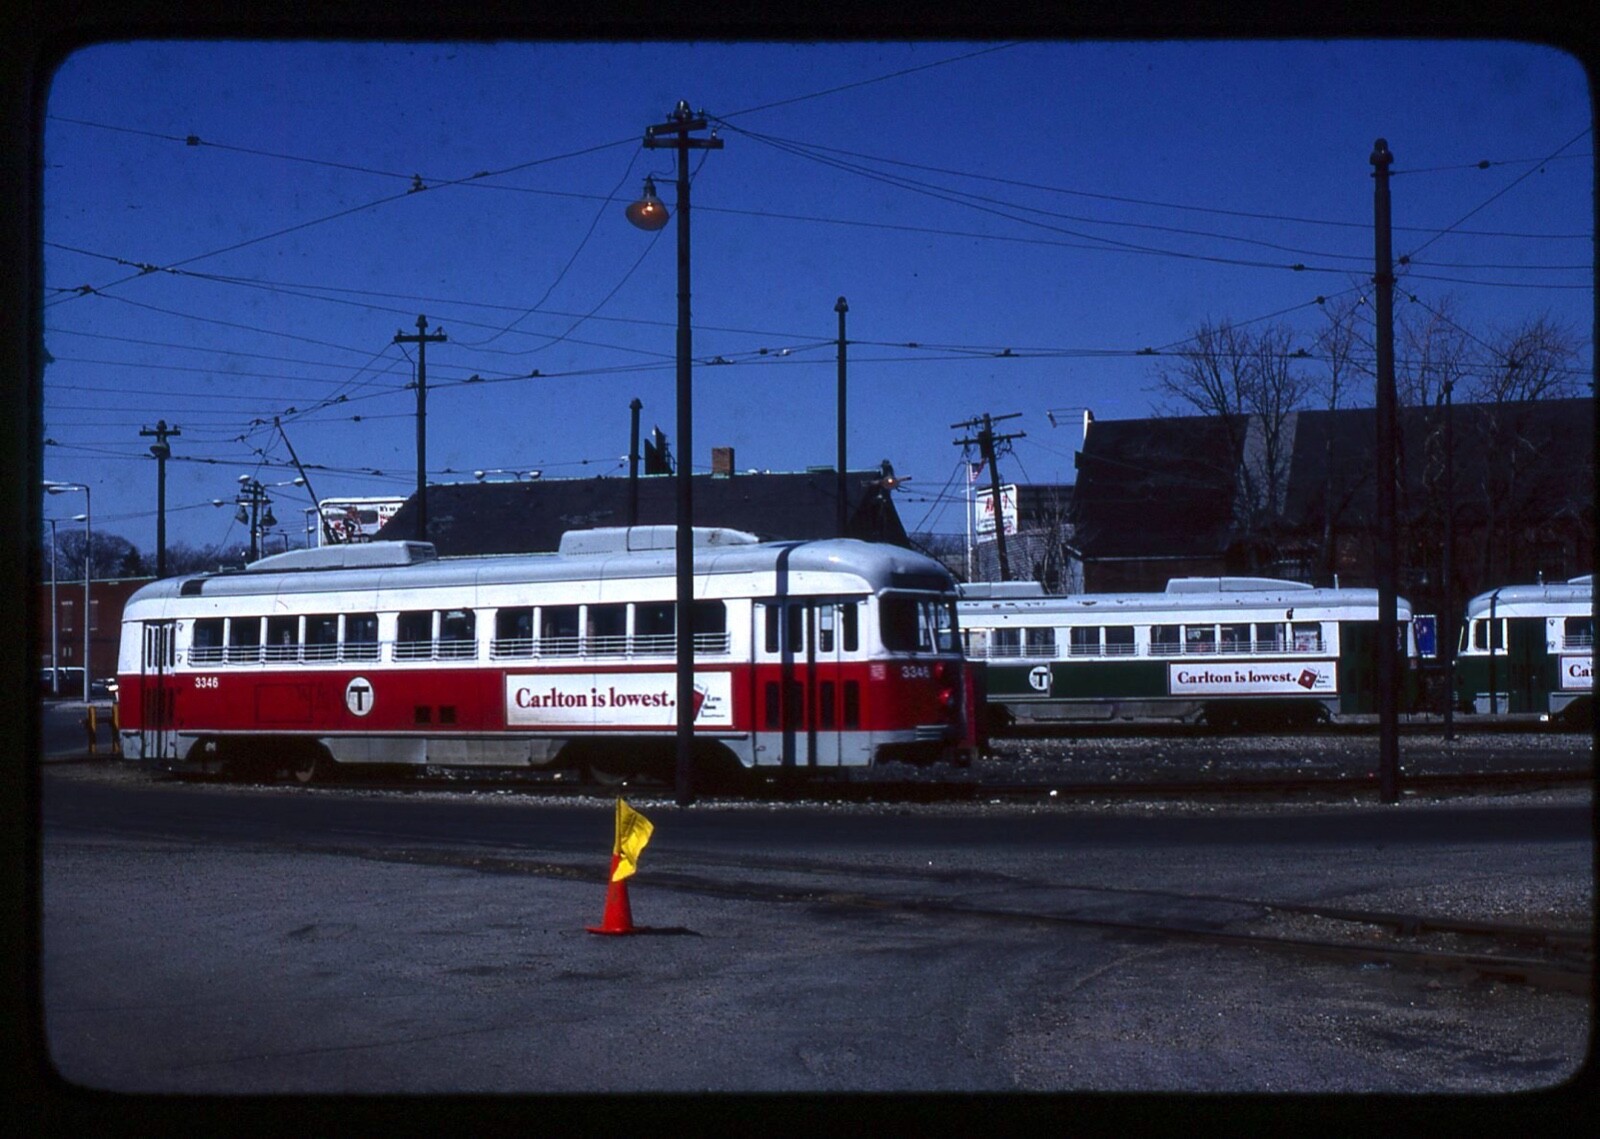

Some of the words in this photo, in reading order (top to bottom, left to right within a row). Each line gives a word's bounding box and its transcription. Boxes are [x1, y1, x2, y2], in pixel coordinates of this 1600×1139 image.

[195, 677, 219, 689] 3346
[1032, 671, 1048, 687] T
[1177, 670, 1232, 684] Carlton
[1235, 671, 1246, 683] is
[1248, 670, 1297, 683] lowest.
[350, 686, 370, 711] T
[515, 687, 586, 708] Carlton
[591, 687, 606, 707] is
[609, 686, 676, 707] lowest.
